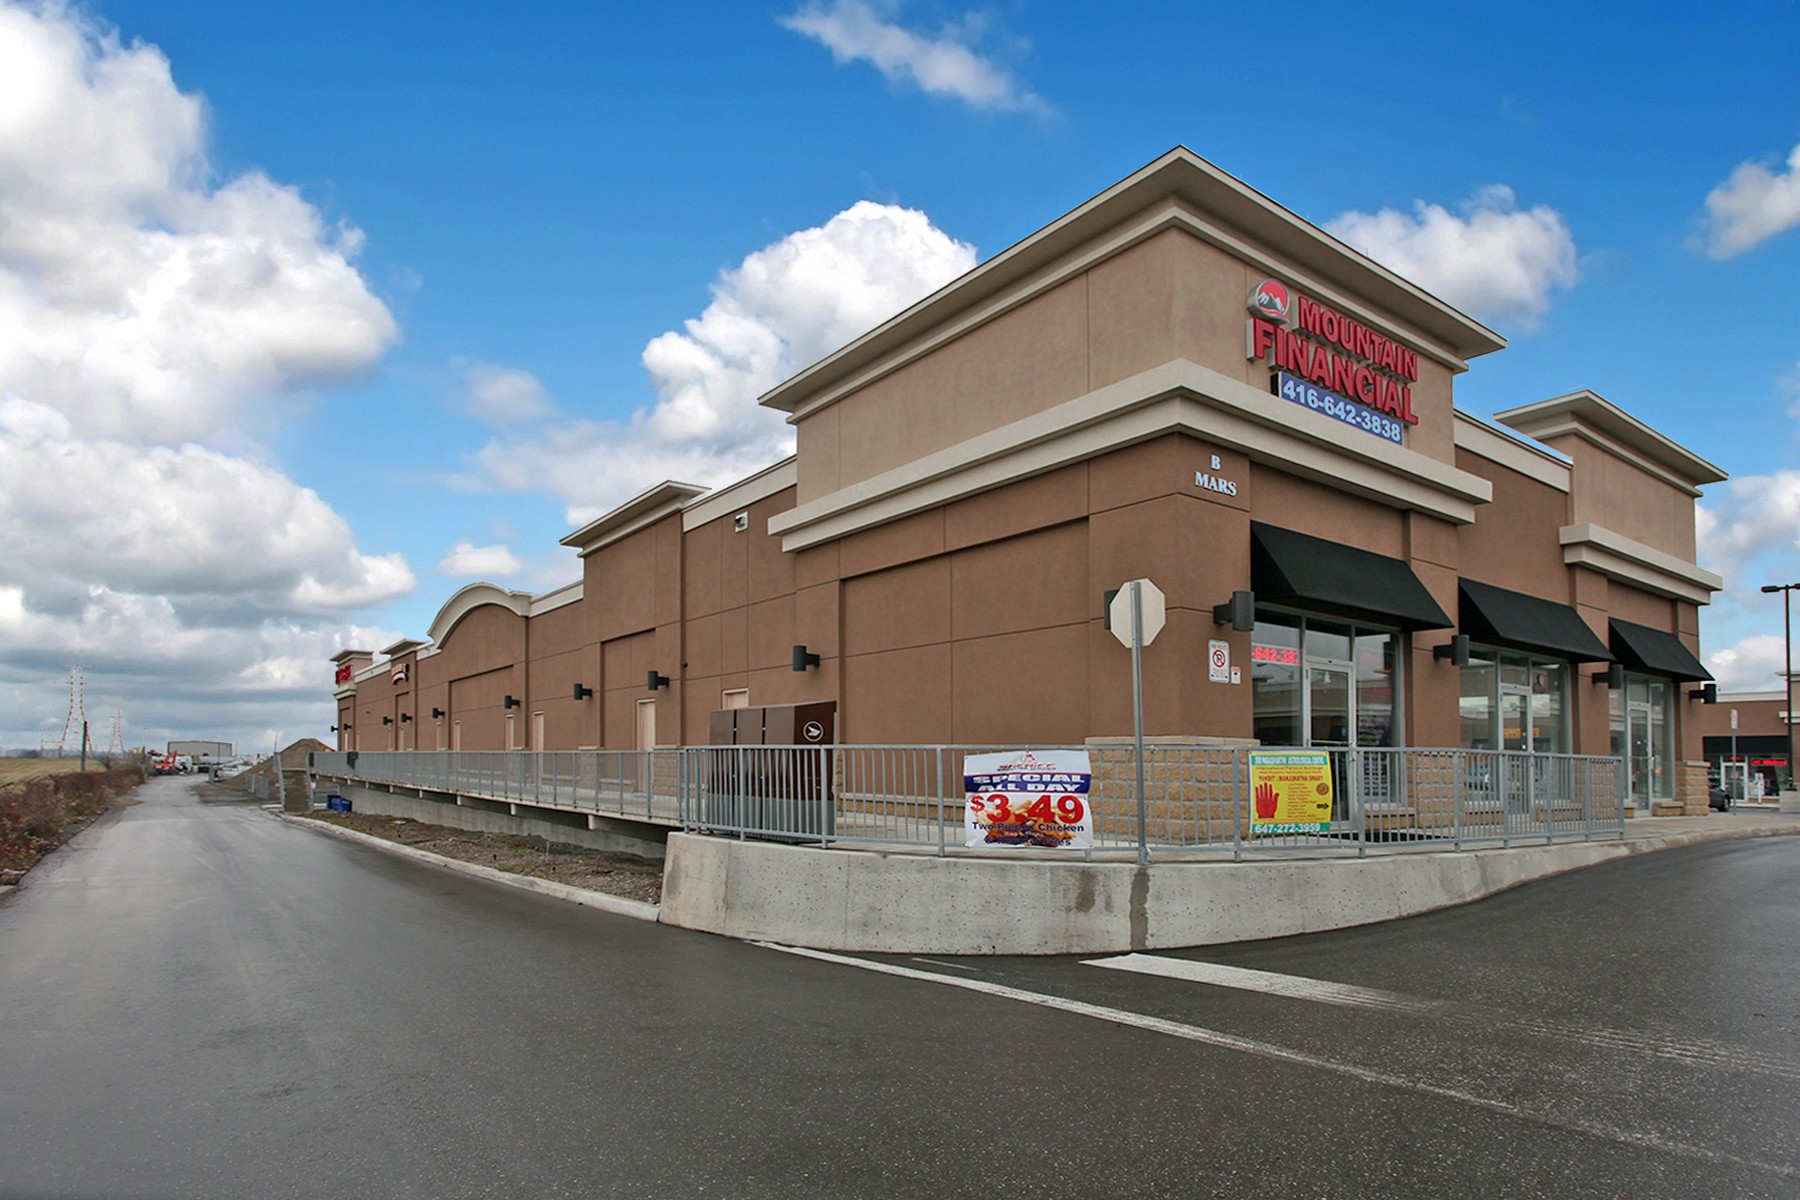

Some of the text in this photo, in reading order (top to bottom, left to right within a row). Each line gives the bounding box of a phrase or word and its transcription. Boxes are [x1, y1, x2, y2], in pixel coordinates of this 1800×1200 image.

[1297, 296, 1418, 383] MOUNTAIN
[1253, 317, 1419, 426] FINANCIAL
[1283, 379, 1402, 443] 416-642-3838
[1211, 454, 1221, 470] B
[1194, 471, 1237, 497] MARS
[972, 774, 1085, 784] SPECIAL
[977, 783, 1080, 792] ALL DAY
[970, 794, 1085, 824] $3.49
[972, 821, 995, 830] Two
[1037, 823, 1085, 833] Chicken
[1254, 823, 1321, 833] 647-272-3959
